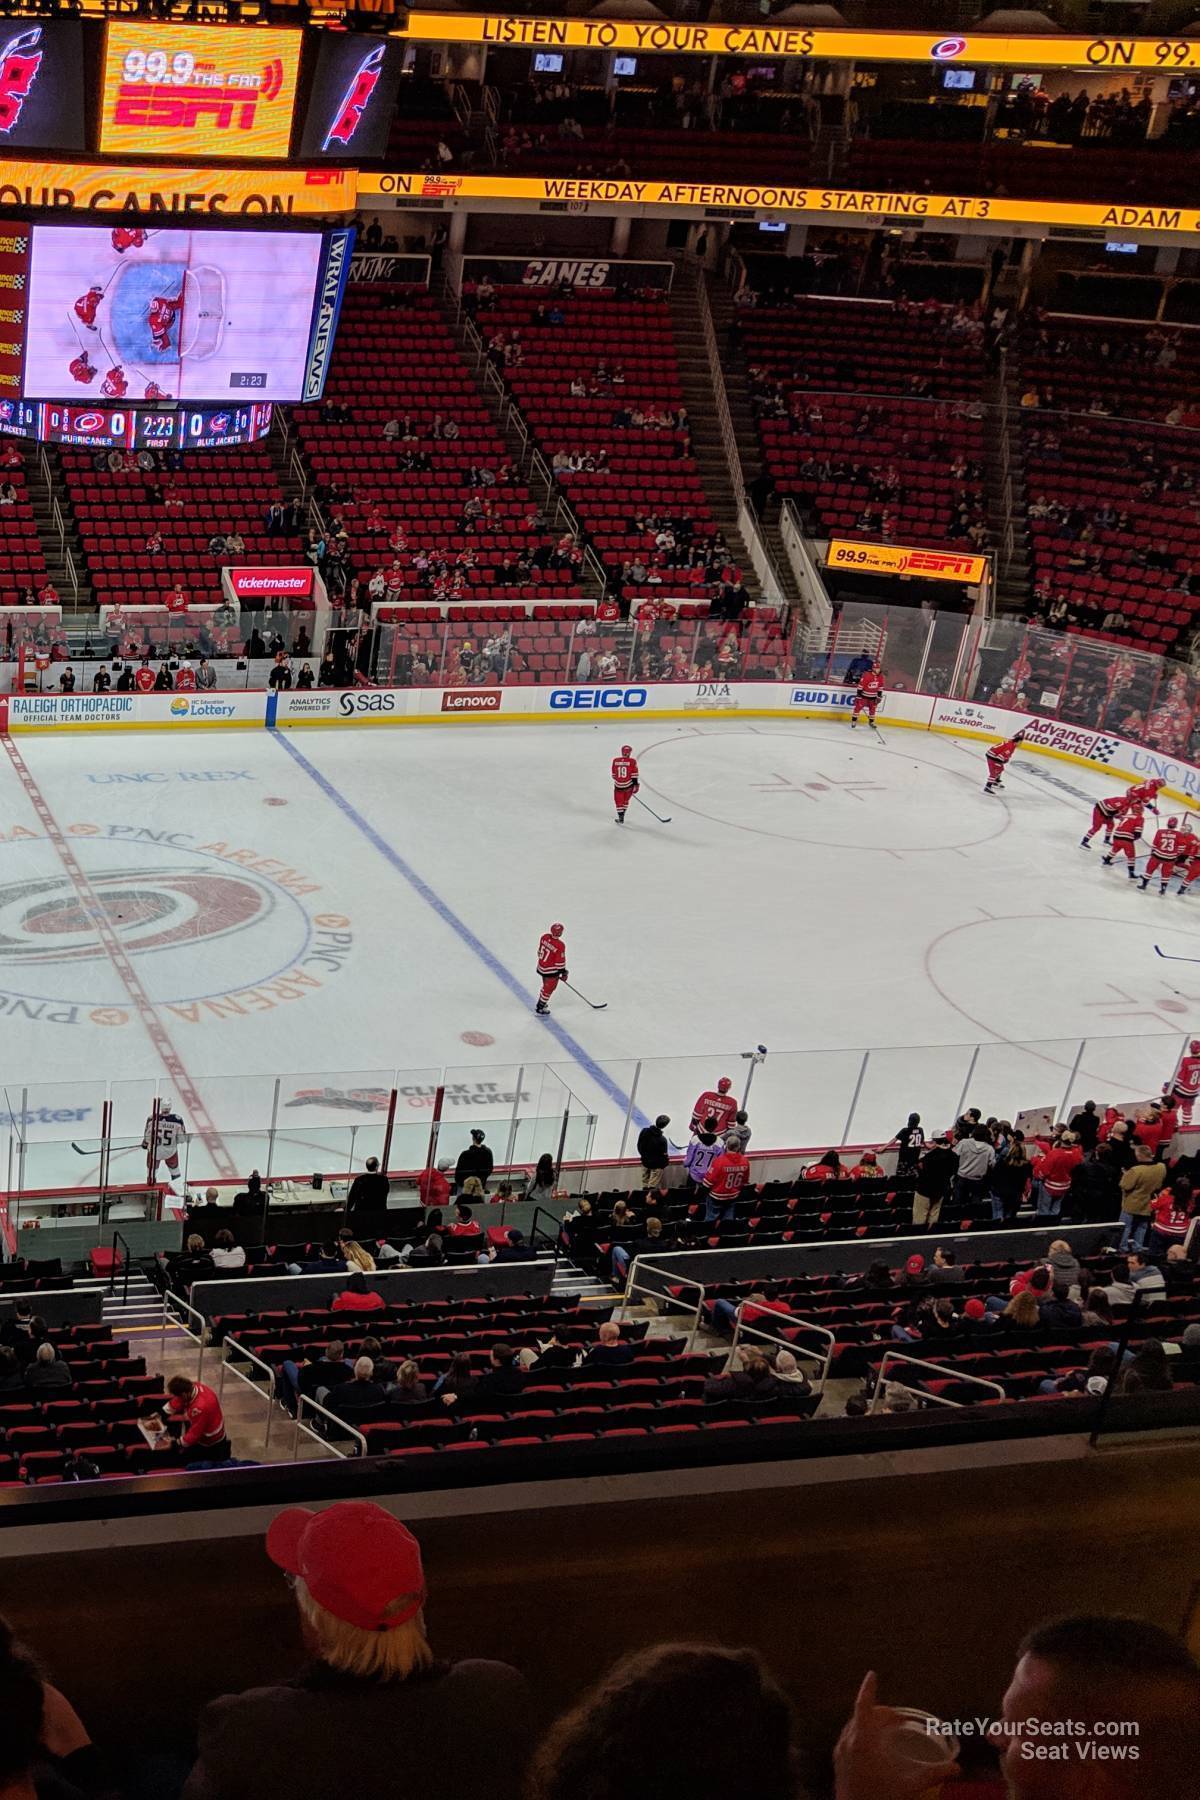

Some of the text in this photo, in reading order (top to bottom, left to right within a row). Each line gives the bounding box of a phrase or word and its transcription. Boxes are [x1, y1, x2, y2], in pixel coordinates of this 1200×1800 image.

[482, 18, 815, 55] LISTEN TO YOUR CANES
[1086, 40, 1196, 67] ON 99.
[122, 50, 195, 84] 99.9
[194, 72, 224, 86] THE
[113, 85, 259, 129] ESPN
[379, 175, 412, 193] ON
[424, 175, 441, 185] 99.9
[421, 184, 457, 196] ESPN
[544, 180, 990, 217] WEEKDAY AFTERNOONS STARTING AT 3
[569, 201, 583, 211] 107
[1102, 207, 1181, 228] ADAM
[349, 257, 397, 282] RNING
[522, 261, 610, 286] CANES
[308, 238, 346, 395] WRAL NEWS
[239, 375, 263, 386] 2:23
[52, 413, 59, 427] 0
[111, 413, 125, 436] 0
[143, 416, 173, 436] 2:23
[190, 413, 203, 436] 0
[241, 413, 247, 429] 0
[62, 434, 113, 446] HURRICANES
[146, 439, 169, 448] FIRST
[196, 435, 241, 447] BLUE JACKETS
[836, 549, 867, 564] 99.9
[908, 552, 974, 575] ESPN
[238, 576, 306, 589] ticketmaster
[696, 683, 731, 697] DNA
[13, 697, 133, 713] RALEIGH ORTHOPAEDIC
[290, 697, 331, 705] ANALYTICS
[357, 693, 395, 711] sas
[446, 694, 497, 707] Lenovo
[550, 688, 647, 709] GEICO
[793, 691, 857, 706] BUD LIG
[23, 714, 58, 722] OFFICIAL
[84, 713, 121, 721] DOCTORS
[191, 704, 235, 717] Lottery
[938, 714, 997, 731] NHLSHOP.com
[1024, 718, 1093, 746] Advance
[1013, 728, 1088, 757] Auto Parts
[1131, 751, 1179, 784] UNC
[85, 769, 256, 785] UNC REX
[1161, 839, 1175, 852] 23
[108, 824, 322, 897] PNC ARENA
[166, 931, 354, 1024] PNC ARENA
[1189, 1070, 1200, 1086] 8
[475, 1082, 499, 1094] IT
[450, 1091, 530, 1106] TICKET
[908, 1133, 922, 1148] 20
[695, 1150, 714, 1168] 27
